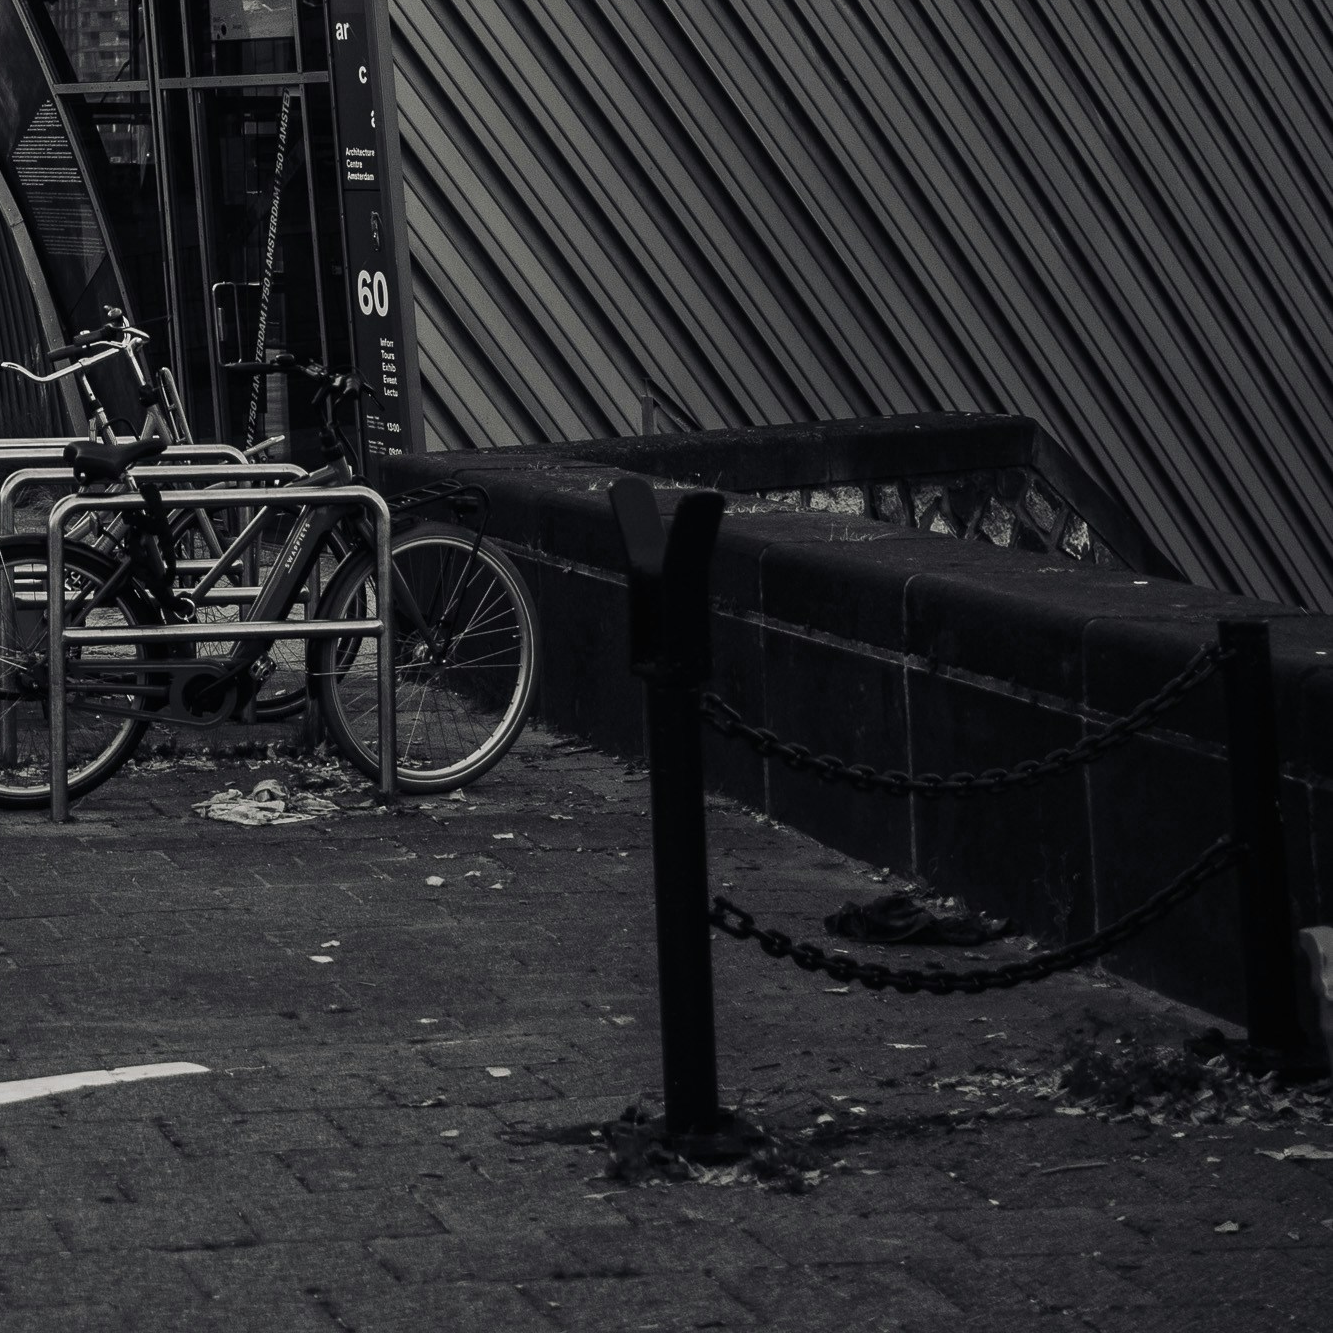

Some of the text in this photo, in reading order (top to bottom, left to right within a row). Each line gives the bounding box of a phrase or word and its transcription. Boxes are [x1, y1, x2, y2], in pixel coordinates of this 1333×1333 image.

[335, 22, 349, 40] ar
[358, 65, 367, 84] c
[347, 171, 375, 182] Amsterdam
[264, 185, 282, 270] AMSTERDAM
[261, 276, 272, 300] 750
[357, 270, 389, 317] 60
[381, 349, 396, 361] Tours
[247, 400, 258, 424] 750
[284, 522, 311, 569] SWAPFIETS
